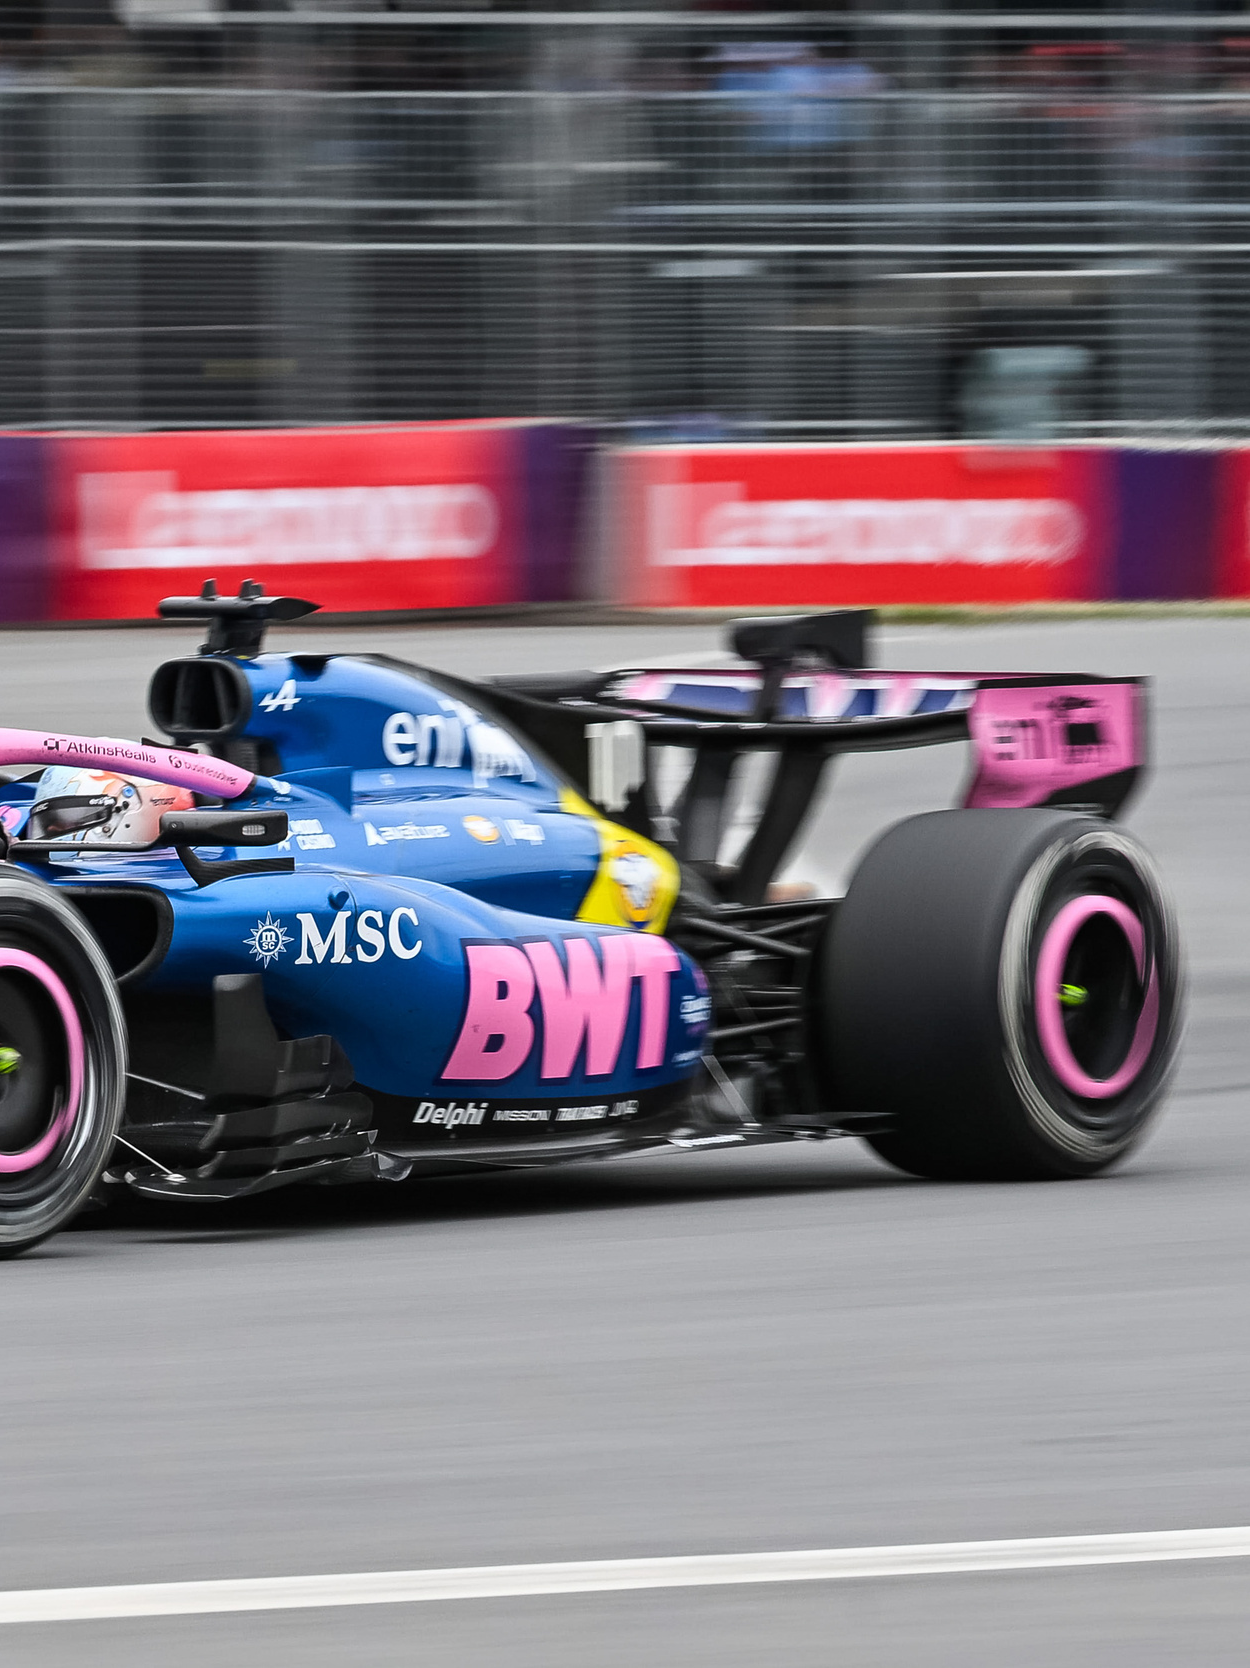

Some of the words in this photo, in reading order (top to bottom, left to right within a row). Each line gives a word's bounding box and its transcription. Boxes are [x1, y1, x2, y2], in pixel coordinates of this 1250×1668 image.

[66, 740, 157, 764] AtkinsRéalis
[295, 907, 422, 965] MSC
[441, 932, 682, 1082] BWT
[413, 1102, 489, 1129] Delphi
